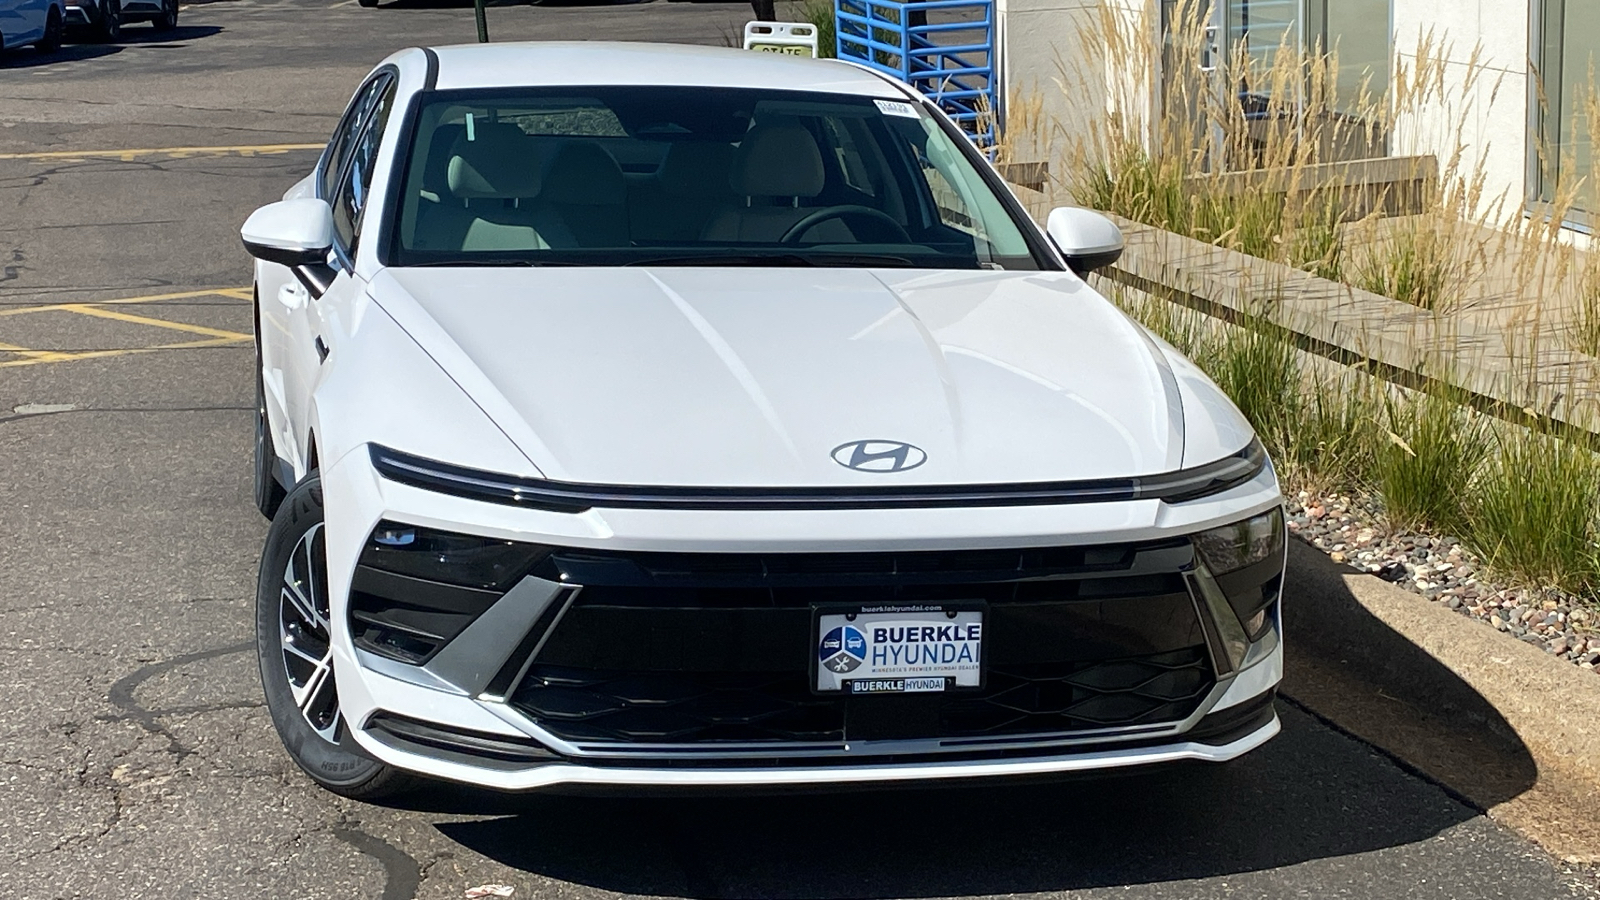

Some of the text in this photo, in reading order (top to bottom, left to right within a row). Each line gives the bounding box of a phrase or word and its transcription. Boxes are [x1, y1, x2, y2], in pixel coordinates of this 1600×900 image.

[873, 625, 980, 644] BUERKLE
[872, 643, 980, 666] HYUNDAI
[853, 679, 943, 691] BUERKLE HYUNDAI
